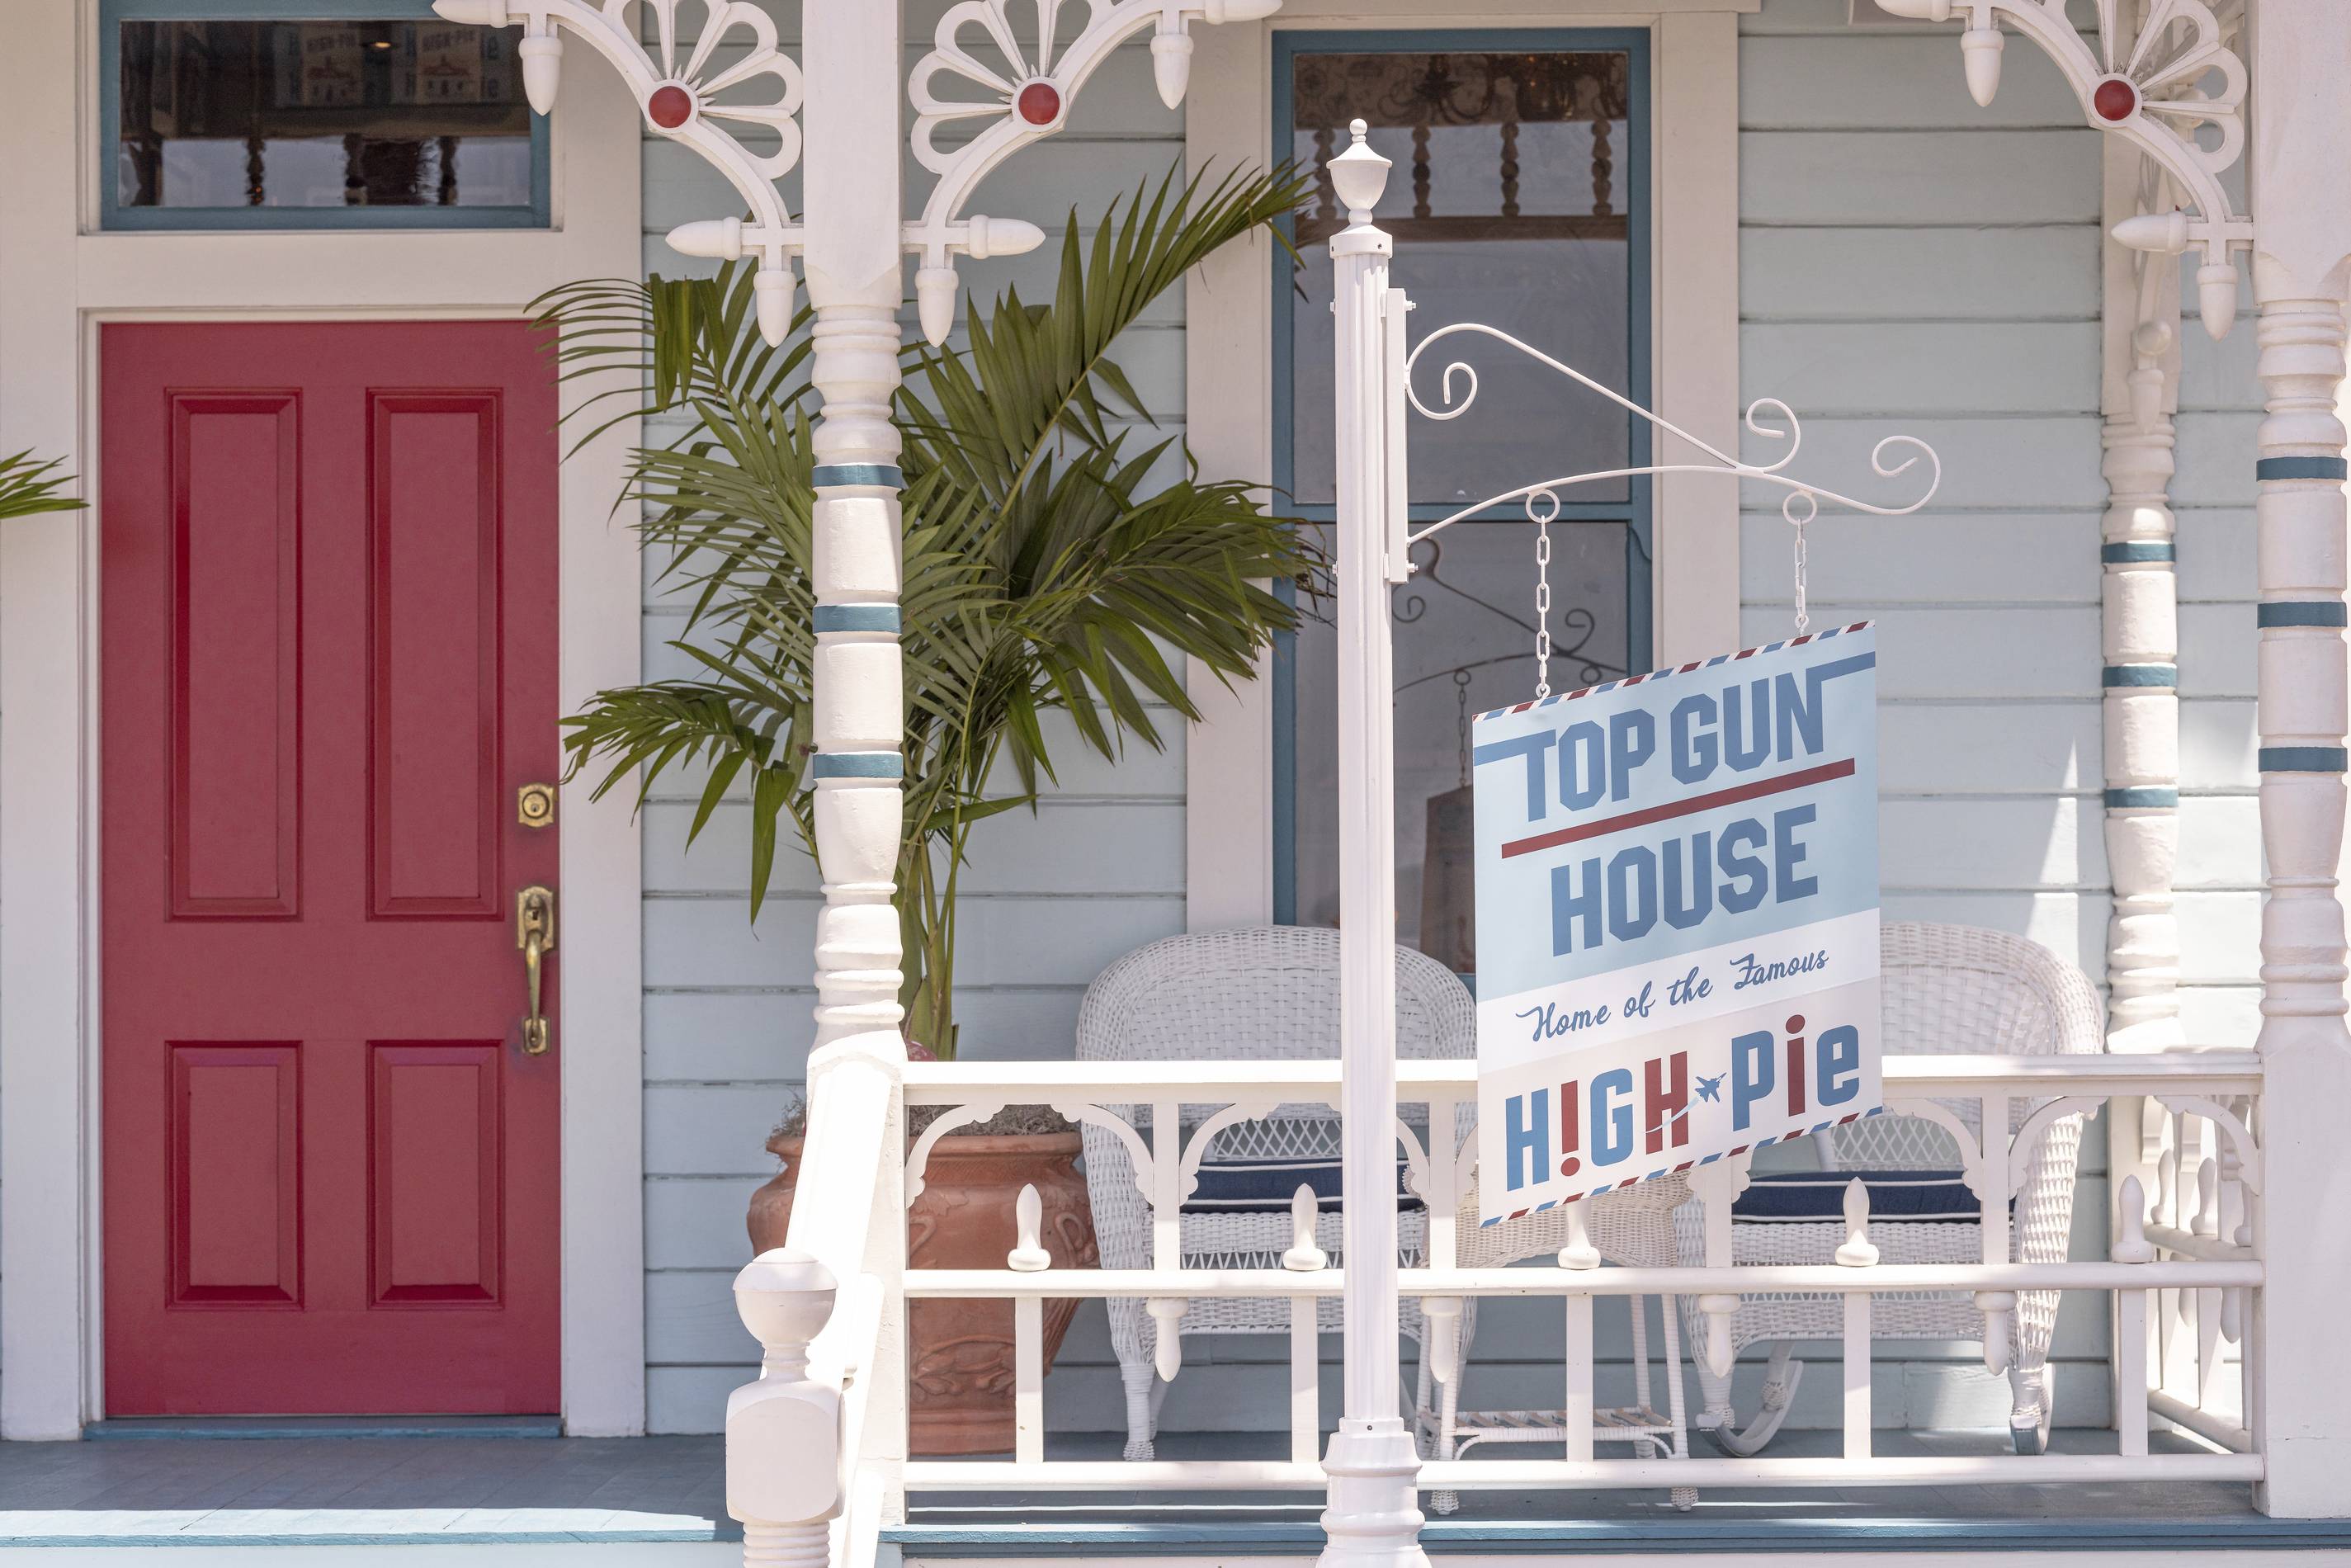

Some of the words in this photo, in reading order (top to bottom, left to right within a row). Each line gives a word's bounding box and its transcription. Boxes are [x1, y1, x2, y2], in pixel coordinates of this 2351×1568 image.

[1474, 709, 1655, 822] TOP
[1670, 651, 1875, 785] GUN
[1551, 803, 1818, 956] HOUSE
[1515, 1002, 1612, 1042] Home
[1623, 980, 1656, 1018] of
[1666, 966, 1714, 1006] the
[1730, 949, 1829, 990] Famous
